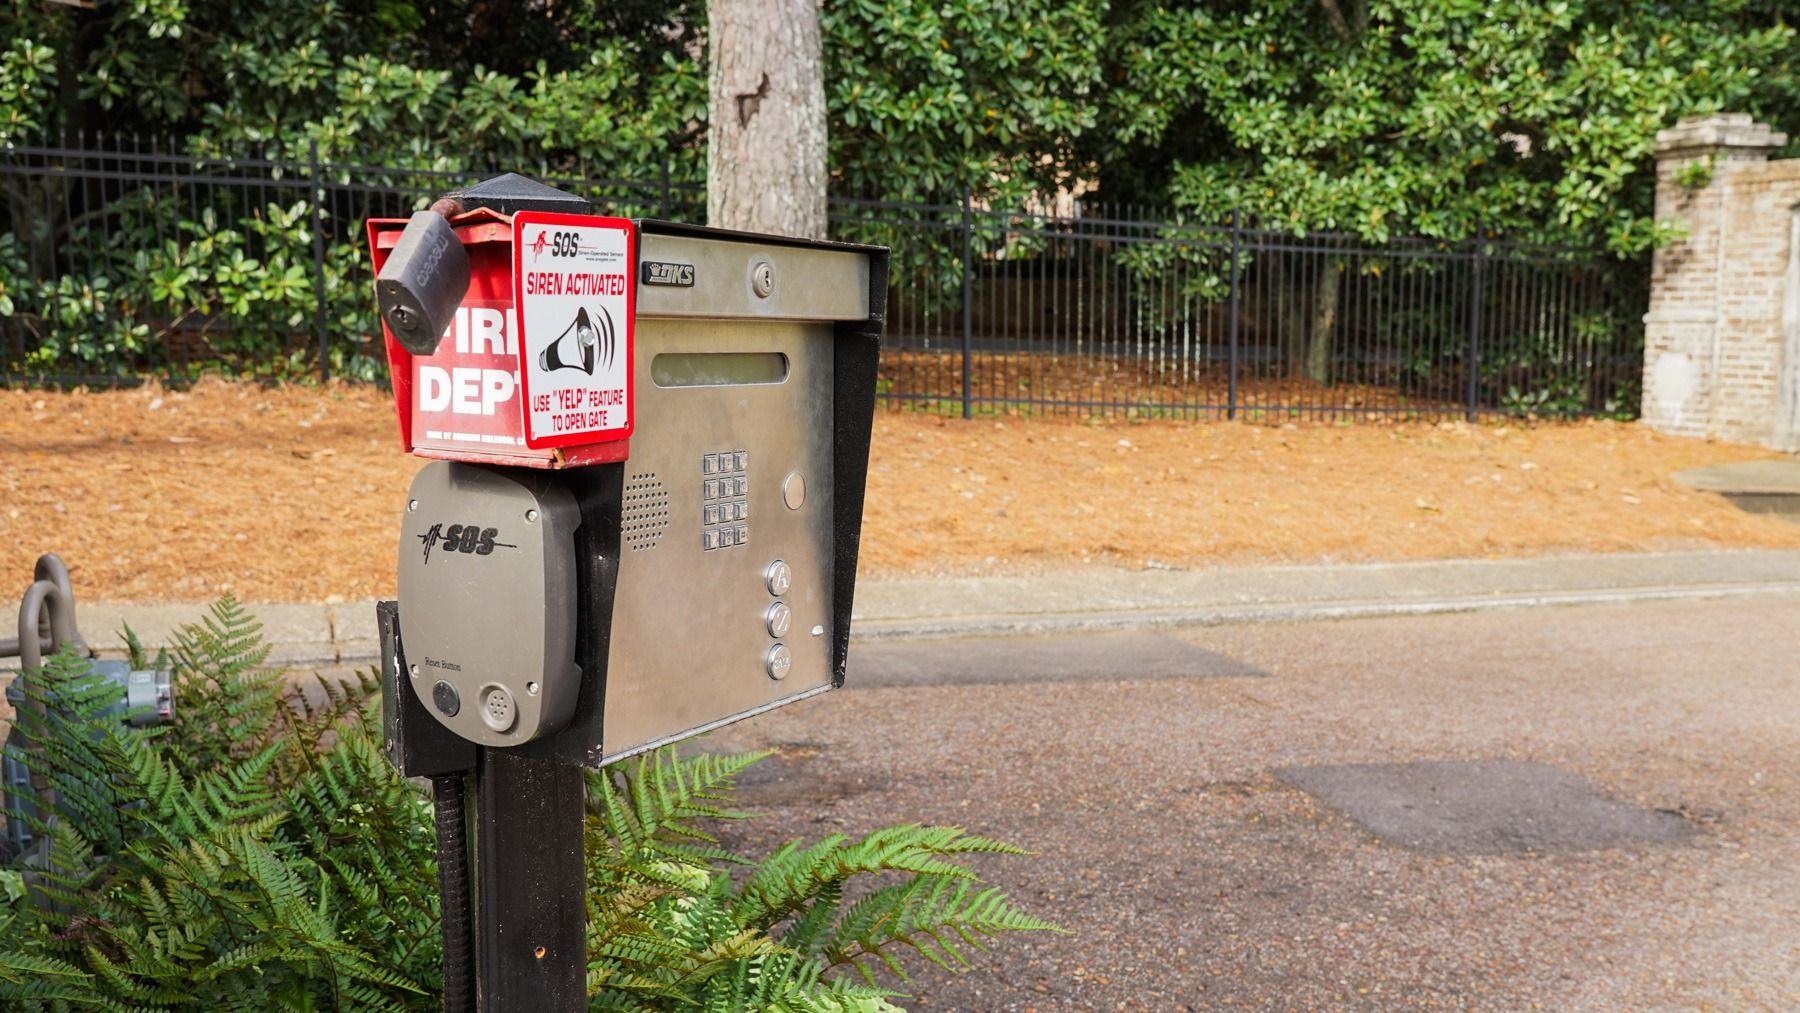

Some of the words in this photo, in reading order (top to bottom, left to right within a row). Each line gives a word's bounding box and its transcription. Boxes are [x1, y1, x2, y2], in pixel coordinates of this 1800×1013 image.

[552, 232, 579, 257] SOS
[527, 272, 563, 295] SIREN
[566, 273, 625, 295] ACTIVATED
[650, 263, 693, 284] DKS
[435, 307, 519, 355] IR
[420, 366, 520, 415] DEP
[533, 395, 550, 412] USE
[553, 388, 587, 409] "YELP"
[589, 389, 623, 407] FEATURE
[552, 415, 562, 431] TO
[565, 413, 586, 430] OPEN
[589, 410, 607, 427] GATE
[443, 524, 498, 555] SOS
[776, 567, 788, 588] A
